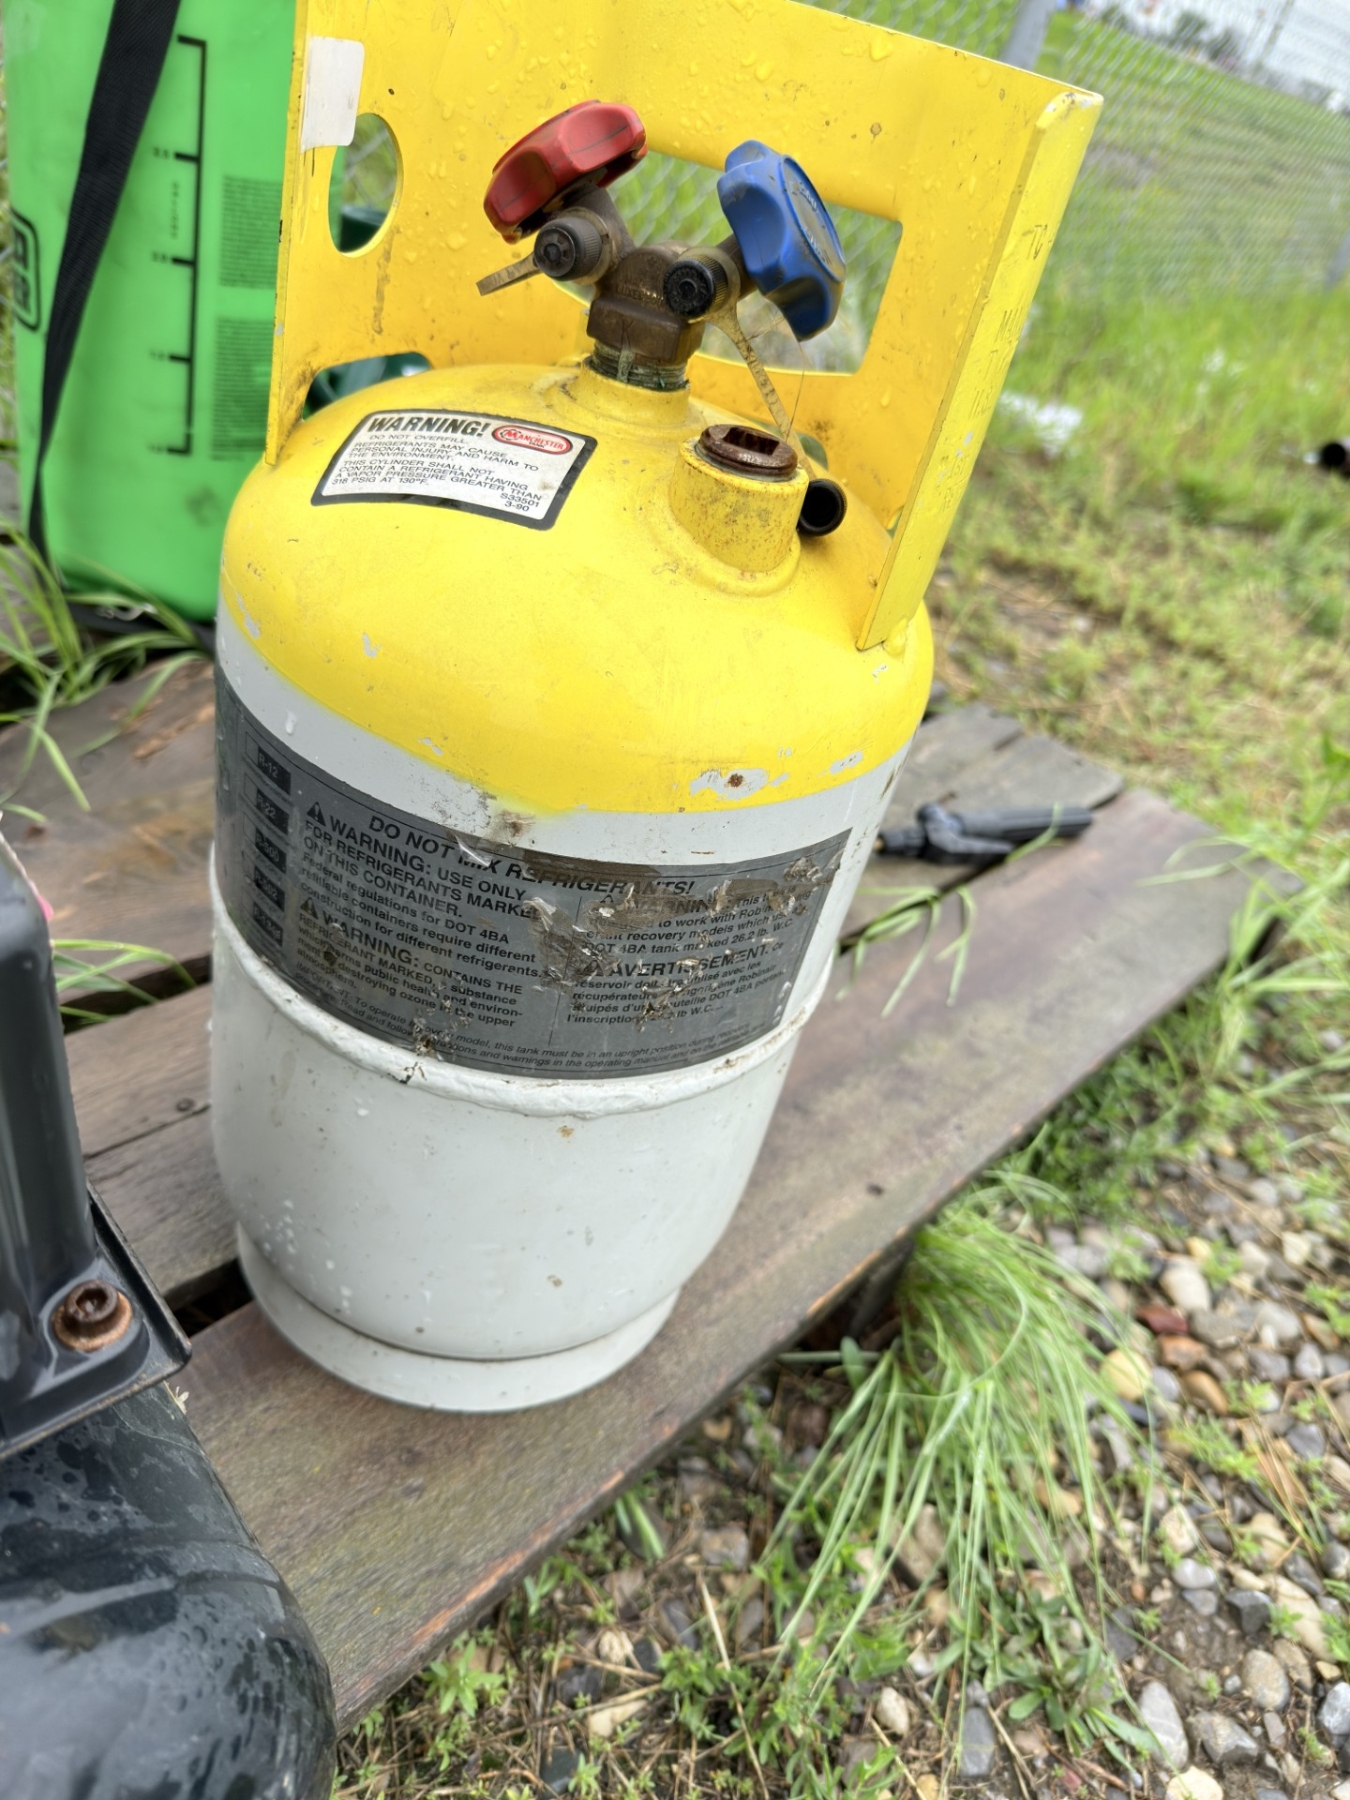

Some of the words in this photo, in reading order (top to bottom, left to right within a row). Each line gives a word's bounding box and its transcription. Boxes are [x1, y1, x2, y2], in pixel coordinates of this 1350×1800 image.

[367, 416, 491, 437] WARNING!
[504, 430, 564, 450] MANCHESTER
[368, 458, 425, 466] CYLINDER
[428, 461, 465, 472] SHALL
[469, 467, 495, 476] NOT
[371, 452, 454, 461] ENVIRONMENT.
[410, 447, 454, 455] INJURY
[454, 451, 480, 459] AND
[483, 455, 519, 467] HARM
[523, 462, 539, 472] TO
[468, 446, 508, 458] CAUSE
[332, 477, 348, 485] 318
[385, 471, 447, 480] PRESSURE
[450, 476, 505, 491] GREATER
[510, 487, 542, 501] THAN
[400, 466, 480, 480] REFRIGERANT
[485, 475, 528, 491] HAVING
[500, 492, 540, 507] S33501
[505, 500, 530, 512] 3-90
[258, 751, 279, 778] R-12
[257, 794, 276, 820] R-22
[256, 832, 280, 863] R-500
[368, 814, 401, 839] DO
[405, 831, 455, 859] NOT
[305, 820, 332, 846] FOR
[336, 839, 462, 902] REFRIGERANTS
[467, 892, 541, 920] MARKE
[329, 815, 431, 875] WARNING:
[438, 866, 474, 889] USE
[478, 880, 526, 901] ONLY
[304, 836, 324, 857] ON
[327, 850, 359, 876] THIS
[363, 870, 463, 918] CONTAINER.
[303, 852, 343, 883] Federal
[346, 879, 418, 917] regulations
[421, 910, 441, 925] for
[444, 918, 477, 936] DOT
[479, 929, 510, 945] 4BA
[300, 881, 371, 927] construction
[374, 921, 393, 936] for
[396, 931, 454, 958] different
[456, 952, 542, 978] refrigerants.
[301, 868, 350, 901] refillable
[351, 897, 419, 932] containers
[422, 927, 472, 949] require
[476, 942, 537, 963] different
[626, 931, 687, 942] recovery
[736, 916, 769, 930] which
[771, 911, 787, 921] us
[675, 916, 707, 928] work
[710, 911, 736, 924] with
[738, 904, 773, 919] Robin
[322, 909, 419, 967] WARNING:
[423, 961, 492, 988] CONTAINS
[495, 980, 523, 995] THE
[651, 943, 680, 954] tank
[683, 936, 729, 951] maked
[730, 931, 755, 945] 26.2
[756, 927, 769, 938] lb.
[297, 948, 357, 989] atmosphere.
[298, 937, 321, 957] ment
[338, 962, 397, 997] destroying
[399, 991, 437, 1009] ozone
[454, 1006, 475, 1019] the
[478, 1014, 516, 1027] upper
[378, 957, 436, 987] MARKED,
[721, 966, 745, 978] avec
[747, 961, 762, 971] les
[364, 964, 400, 985] public
[469, 1000, 524, 1017] environ-
[450, 984, 517, 1005] substance
[571, 1002, 619, 1014] uipés
[709, 989, 733, 1002] DOT
[734, 983, 753, 994] 4BA
[340, 999, 366, 1017] Read
[366, 1013, 385, 1026] and
[479, 1050, 501, 1059] and
[502, 1053, 551, 1067] warnings
[552, 1058, 564, 1066] in
[565, 1059, 582, 1067] the
[584, 1058, 632, 1068] operating
[355, 996, 367, 1007] To
[369, 1003, 406, 1024] operate
[455, 1035, 490, 1049] model,
[494, 1042, 514, 1052] this
[516, 1045, 539, 1055] tank
[541, 1049, 569, 1058] must
[571, 1050, 584, 1058] be
[586, 1050, 597, 1058] in
[614, 1047, 649, 1059] upright
